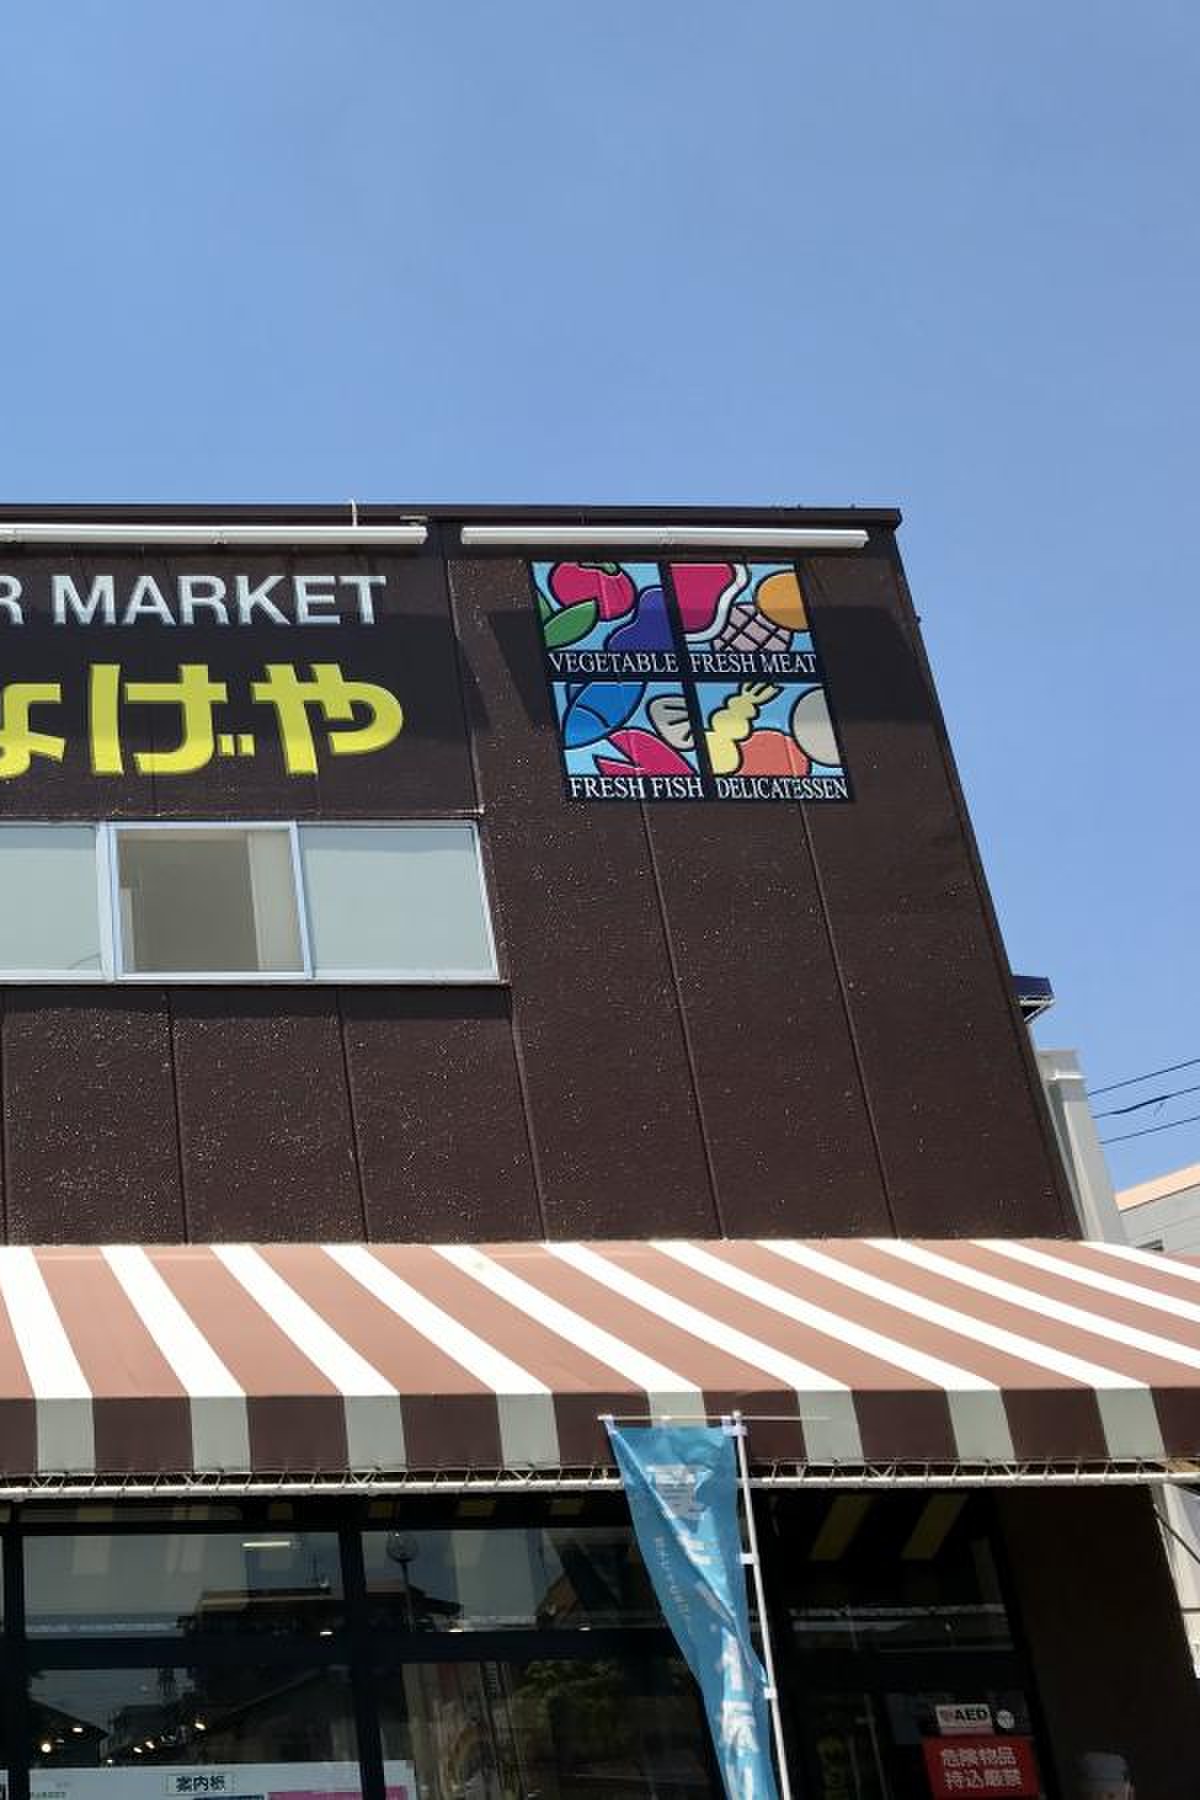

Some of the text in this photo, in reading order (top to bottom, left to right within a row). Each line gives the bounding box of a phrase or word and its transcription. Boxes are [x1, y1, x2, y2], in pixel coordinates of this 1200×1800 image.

[53, 574, 386, 626] MARKET
[549, 653, 679, 674] VEGETABLE
[689, 653, 817, 674] FRESH MEAT
[570, 777, 705, 799] FRESH FISH
[716, 777, 849, 799] DELICATESSEN
[954, 1708, 988, 1722] AED
